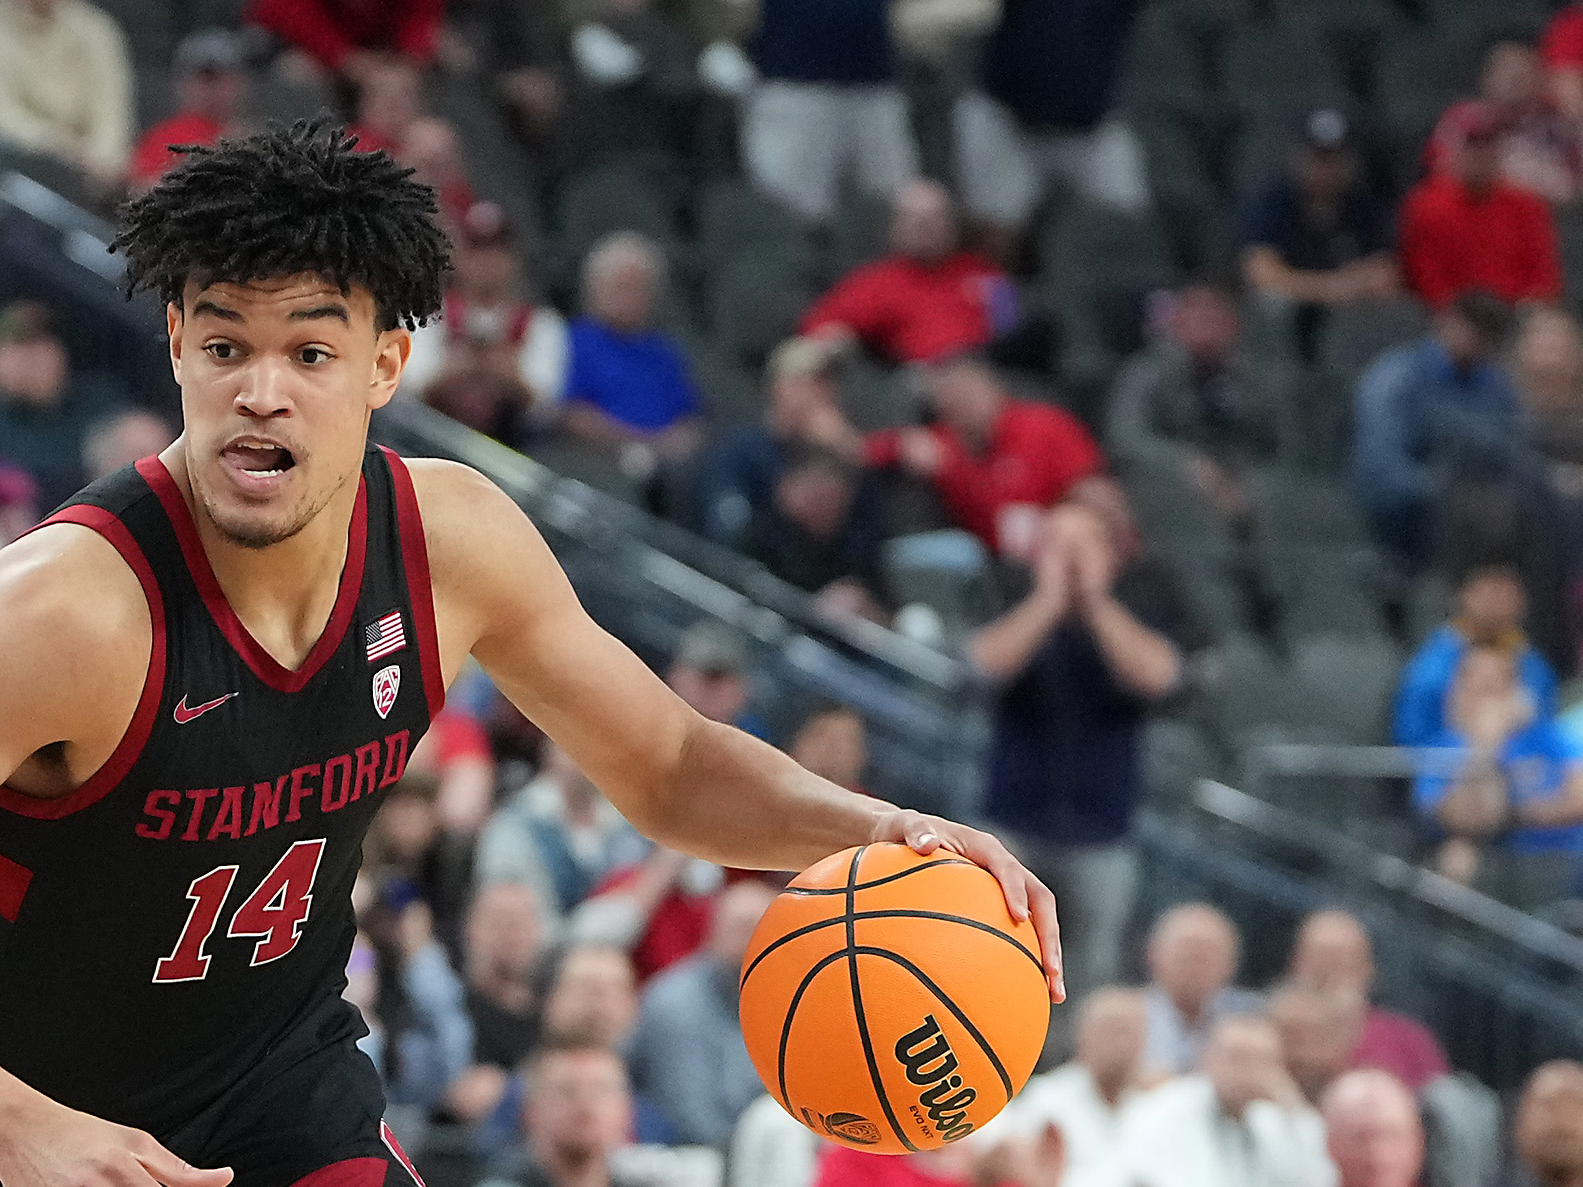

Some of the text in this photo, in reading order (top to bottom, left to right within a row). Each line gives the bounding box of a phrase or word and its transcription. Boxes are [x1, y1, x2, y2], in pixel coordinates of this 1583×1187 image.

[376, 668, 399, 695] PAC
[378, 687, 393, 708] 12
[135, 728, 410, 841] STANFORD
[152, 838, 327, 983] 14
[893, 1013, 977, 1143] Wilso
[909, 1105, 934, 1140] EVO NXT
